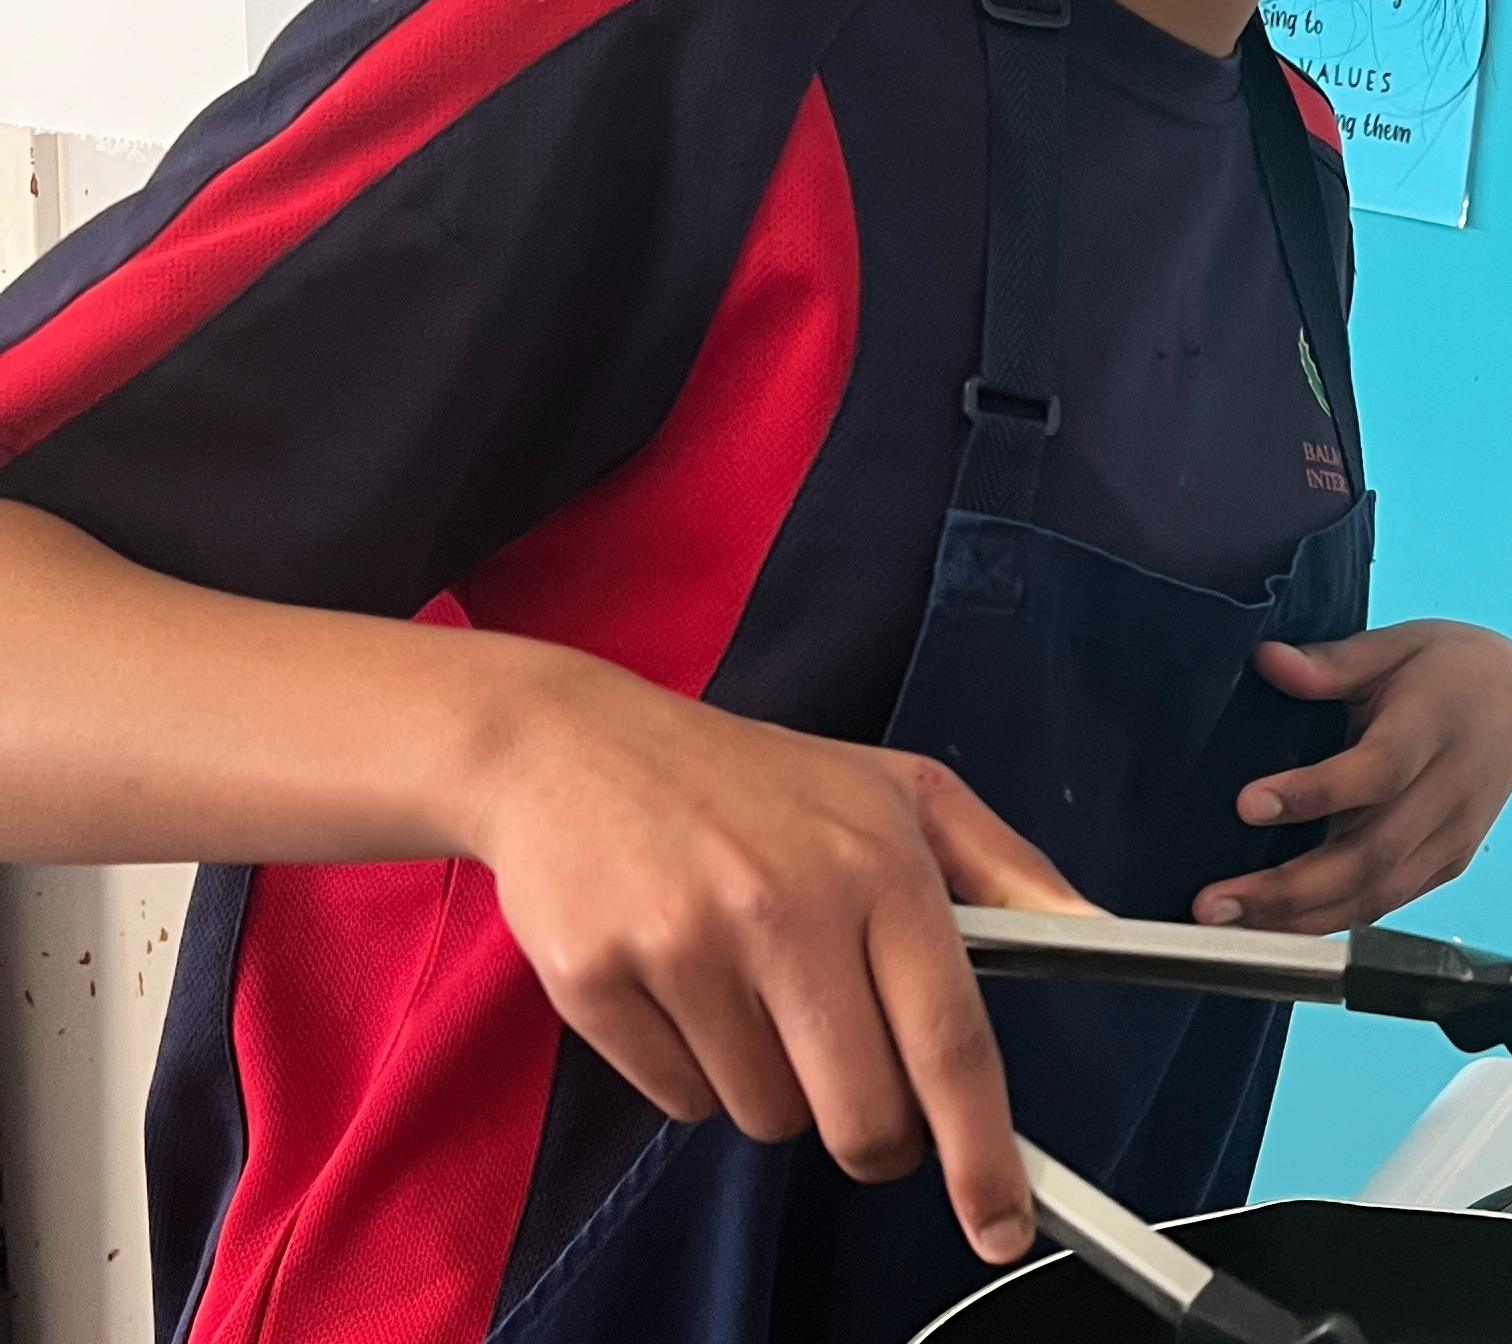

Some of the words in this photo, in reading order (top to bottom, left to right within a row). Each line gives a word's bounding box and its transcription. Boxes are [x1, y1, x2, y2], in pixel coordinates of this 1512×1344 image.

[1305, 9, 1323, 35] to
[1300, 57, 1392, 93] VALUES
[1363, 112, 1412, 144] them
